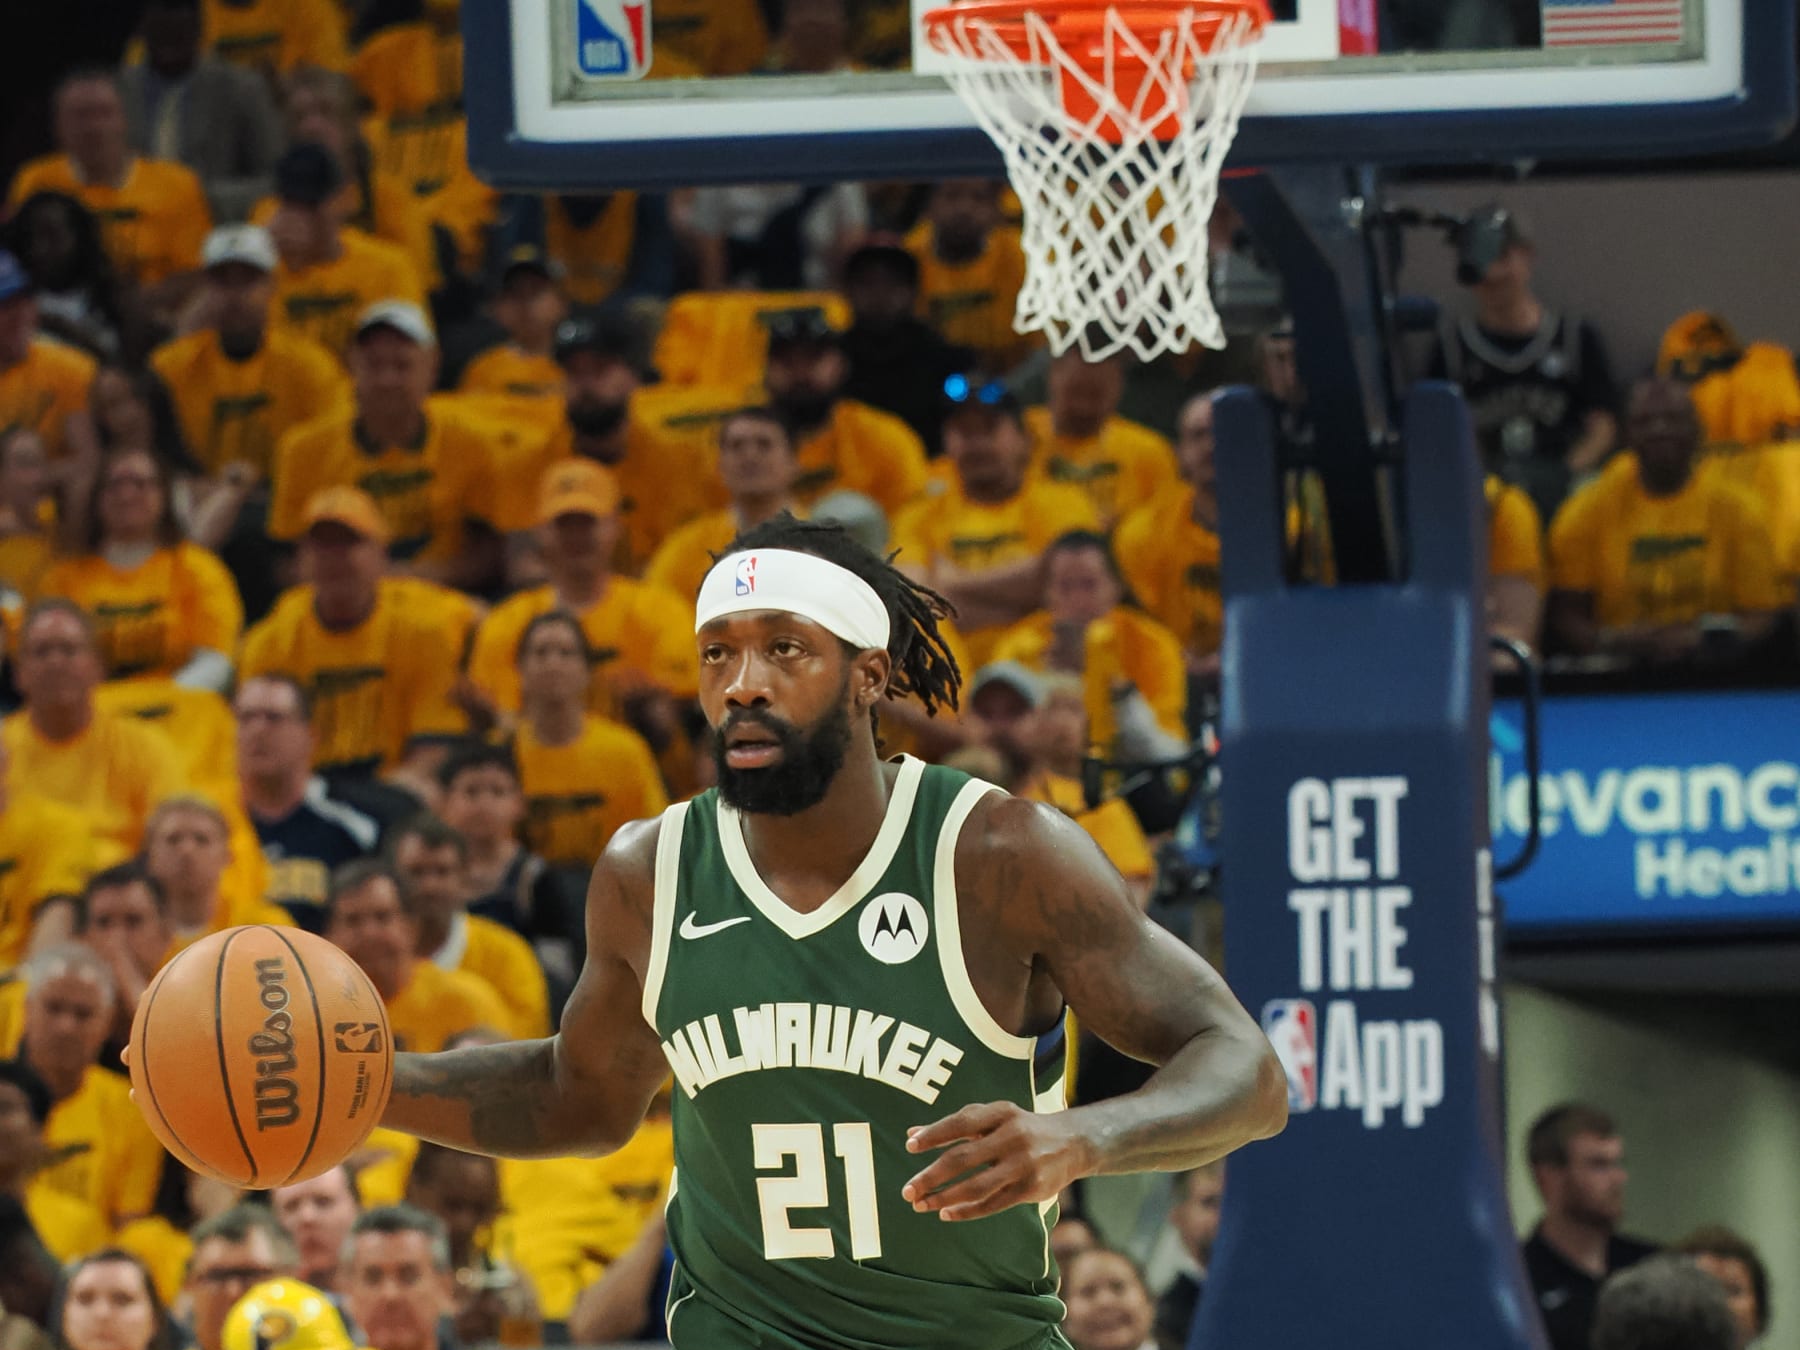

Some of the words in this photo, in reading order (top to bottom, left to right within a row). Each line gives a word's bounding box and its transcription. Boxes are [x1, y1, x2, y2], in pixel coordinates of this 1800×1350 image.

[1287, 776, 1409, 882] GET
[1489, 751, 1800, 837] levanc
[1287, 886, 1414, 992] THE
[249, 958, 301, 1132] Wilson
[661, 1002, 965, 1105] MILWAUKEE
[1320, 1000, 1445, 1129] App
[751, 1122, 882, 1261] 21
